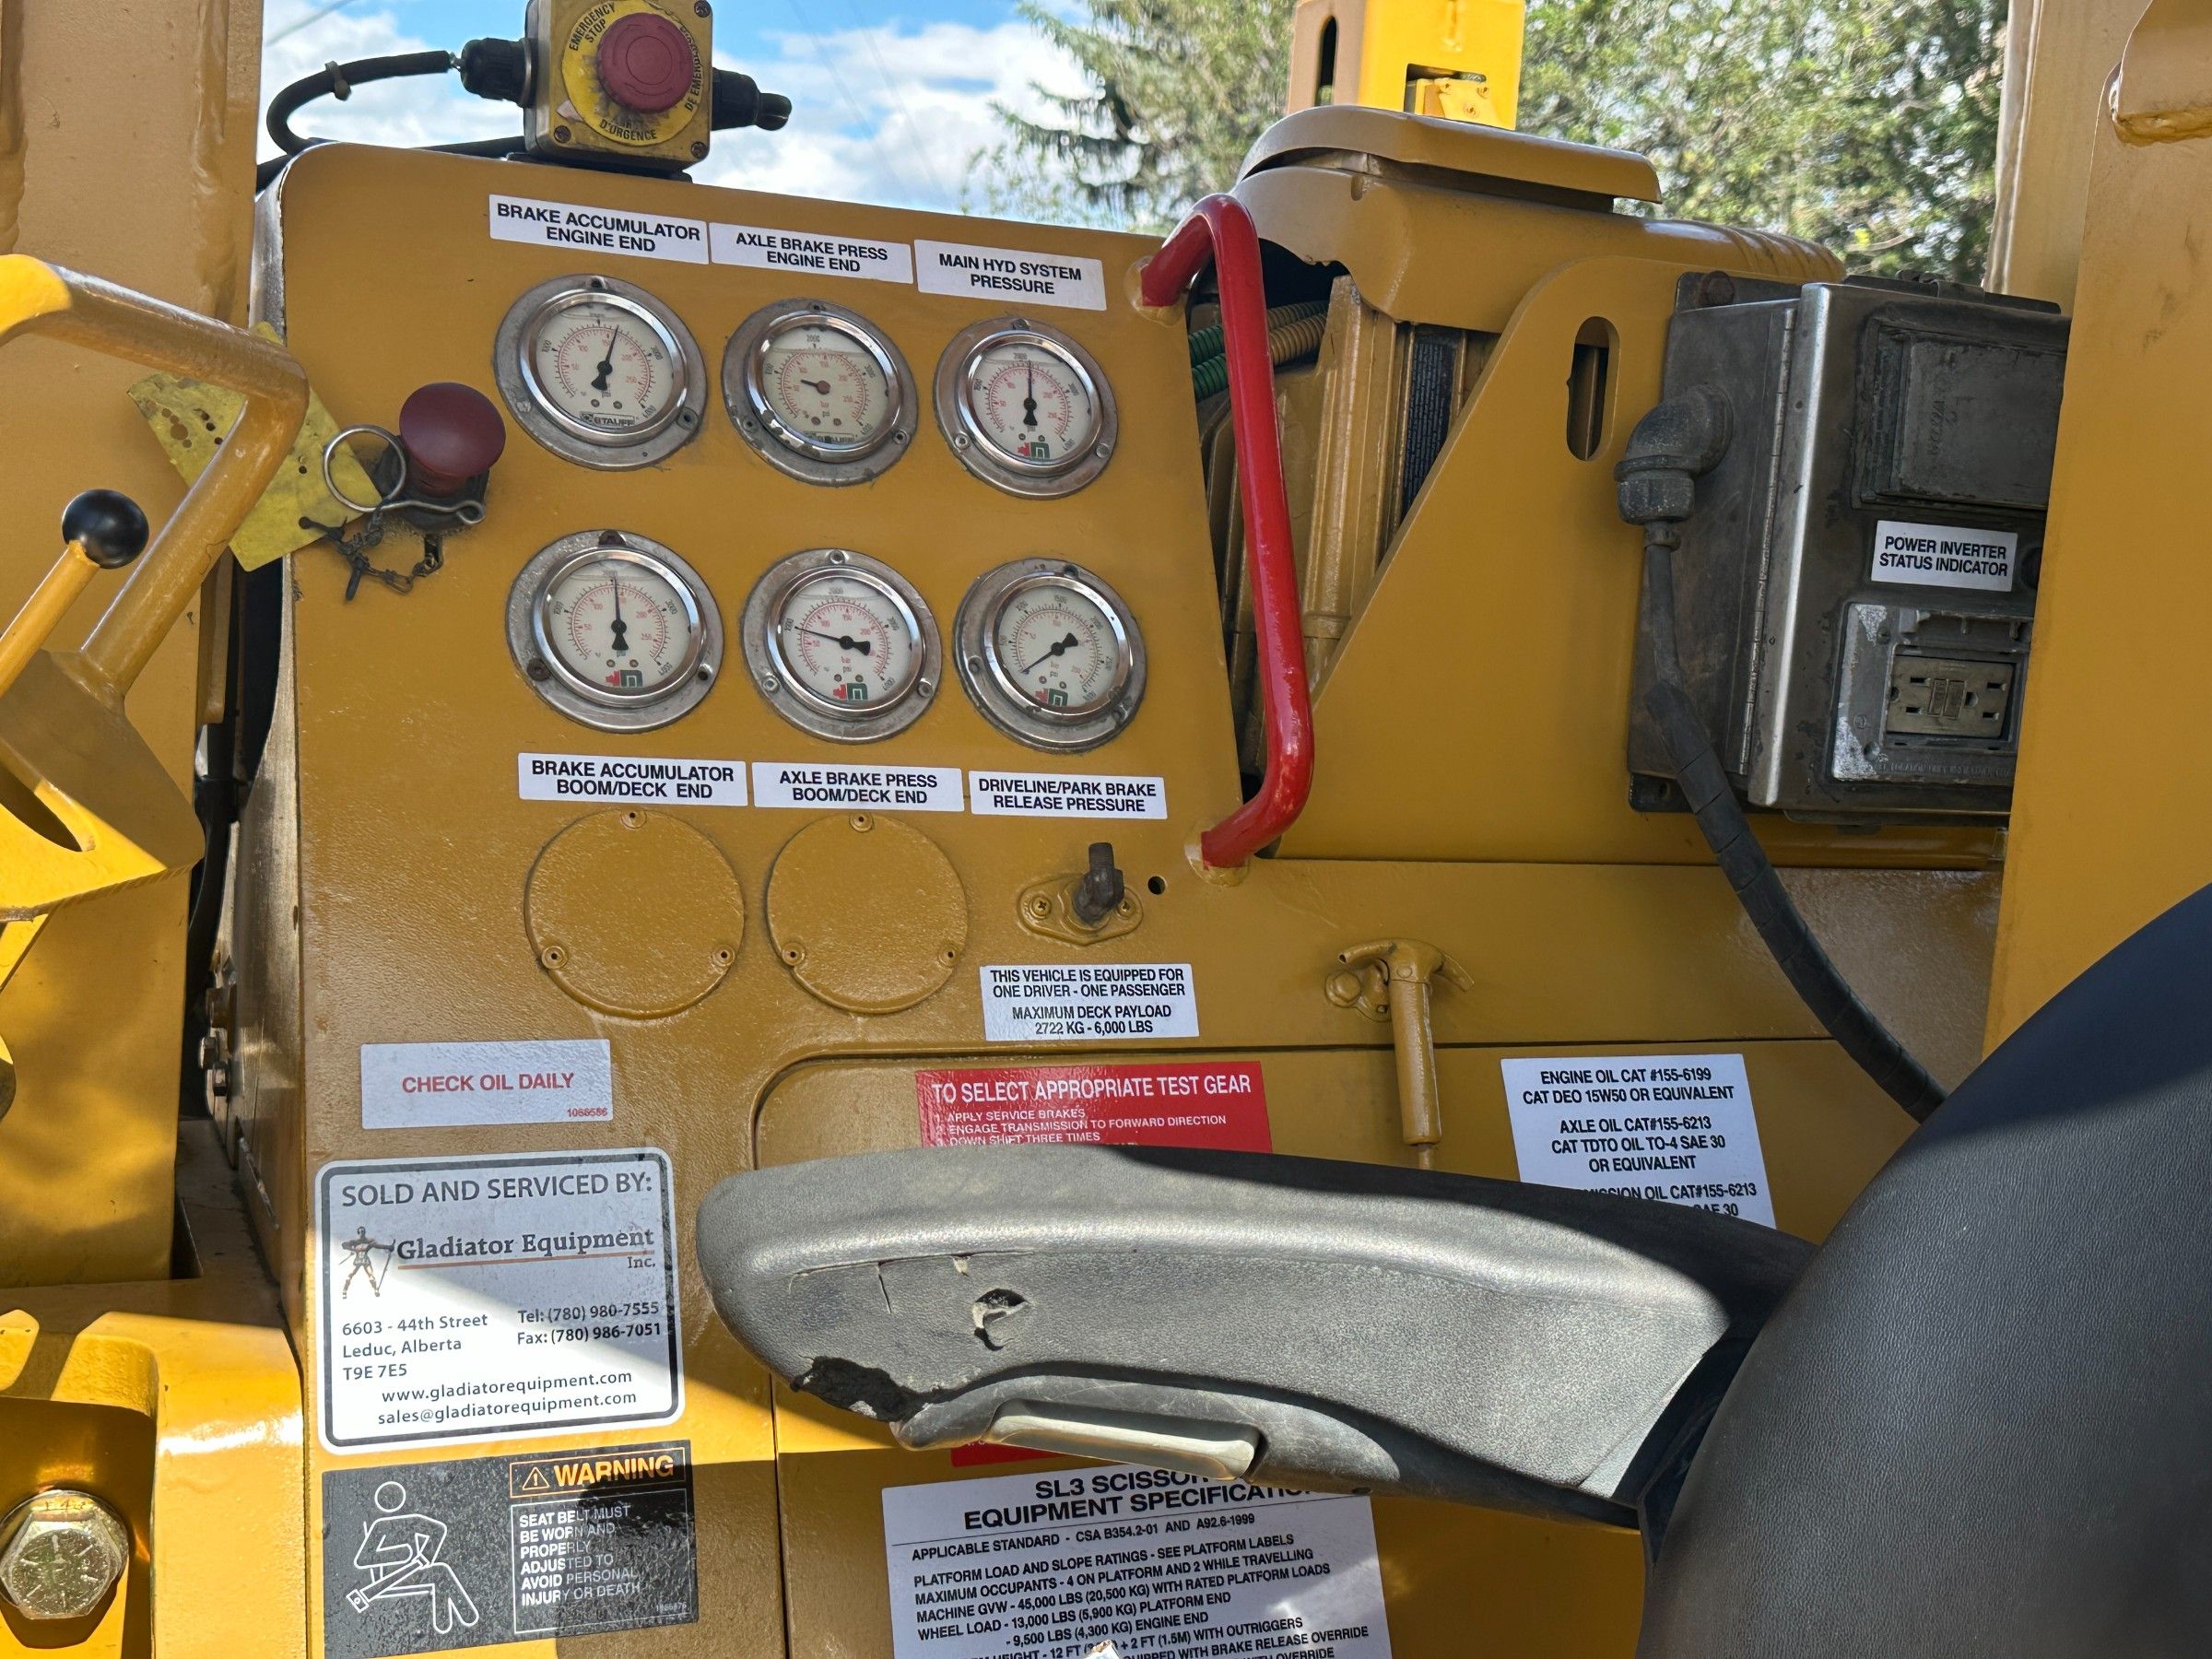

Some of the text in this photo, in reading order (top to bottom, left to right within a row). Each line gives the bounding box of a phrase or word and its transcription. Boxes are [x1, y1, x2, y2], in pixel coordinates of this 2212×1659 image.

[569, 2, 617, 52] EMERGENCY
[584, 18, 606, 43] STOP
[599, 120, 657, 141] D'URGENCE
[497, 202, 700, 241] BRAKE ACCUMULATOR
[547, 226, 656, 253] ENGINE END
[735, 232, 888, 261] AXLE BRAKE PRESS
[767, 250, 861, 273] ENGINE END
[938, 253, 1082, 281] MAIN HYD SYSTEM
[970, 273, 1055, 295] PRESSURE
[1884, 535, 2006, 560] POWER INVERTER
[1879, 552, 2008, 577] STATUS INDICATOR
[532, 759, 735, 782] BRAKE ACCUMULATOR
[780, 770, 938, 789] AXLE BRAKE PRESS
[557, 779, 713, 799] BOOM/DECK END
[793, 787, 928, 804] BOOM/DECK END
[979, 778, 1157, 797] DRIVELINE/PARK BRAKE
[994, 794, 1146, 812] RELEASE PRESSURE
[989, 968, 1184, 983] THIS VEHICLE IS EQUIPPED FOR
[993, 982, 1186, 998] ONE DRIVER ONE PASSENGER
[1012, 1005, 1172, 1020] MAXIMUM DECK PAYLOAD
[1035, 1019, 1154, 1037] 2722 KG 6,000 LBS
[402, 1072, 574, 1094] CHECK OIL DAILY
[1540, 1067, 1712, 1085] ENGINE OIL CAT #155-6199
[931, 1074, 1252, 1104] TO SELECT APPROPRIATE TEST GEAR
[1523, 1085, 1735, 1105] CAT DEO 15W50 OR EQUIVALENT
[947, 1108, 1086, 1123] APPLY SERVICE BRAKES
[948, 1115, 1227, 1135] ENGAGE TRANSMISSION TO FORWARD DIRECTION
[1559, 1115, 1712, 1135] AXLE OIL CAT#155-6213
[949, 1131, 1100, 1146] DOWN SHIFT THREE TIMES
[1551, 1135, 1726, 1154] CAT TDTO OIL TO-4 SAE 30
[1588, 1154, 1697, 1173] OR EQUIVALENT
[342, 1171, 653, 1207] SOLD AND SERVICED BY:
[1644, 1185, 1668, 1200] OIL
[1670, 1182, 1757, 1199] CAT#155-6213
[396, 1229, 655, 1260] Gladiator Equipment
[627, 1255, 656, 1269] Inc.
[517, 1301, 659, 1324] Tel: (780) 980-7555
[342, 1314, 488, 1335] 6603 44th Street
[517, 1322, 661, 1345] Fax: (780) 986-7051
[343, 1338, 462, 1359] Leduc, Alberta
[343, 1363, 407, 1381] T9E 7E5
[382, 1372, 632, 1403] www.gladiatorequipment.com
[378, 1394, 636, 1425] sales@gladiatorequipment.com
[553, 1455, 674, 1488] WARNING
[1035, 1478, 1084, 1499] SL3
[519, 1505, 631, 1528] SEAT BELT MUST
[964, 1496, 1124, 1530] EQUIPMENT
[520, 1523, 616, 1544] BE WORN AND
[912, 1541, 991, 1561] APPLICABLE
[992, 1534, 1060, 1552] STANDARD
[1076, 1529, 1102, 1543] CSA
[1103, 1523, 1159, 1540] B354.2-01
[1165, 1519, 1191, 1534] AND
[520, 1540, 591, 1559] PROPERLY
[520, 1554, 614, 1575] ADJUSTED TO
[913, 1533, 1295, 1588] PLATFORM LOAD AND SLOPE RATINGS SEE PLATFORM LABELS
[521, 1567, 640, 1591] AVOID PERSONAL
[522, 1582, 641, 1606] INJURY OR DEATH
